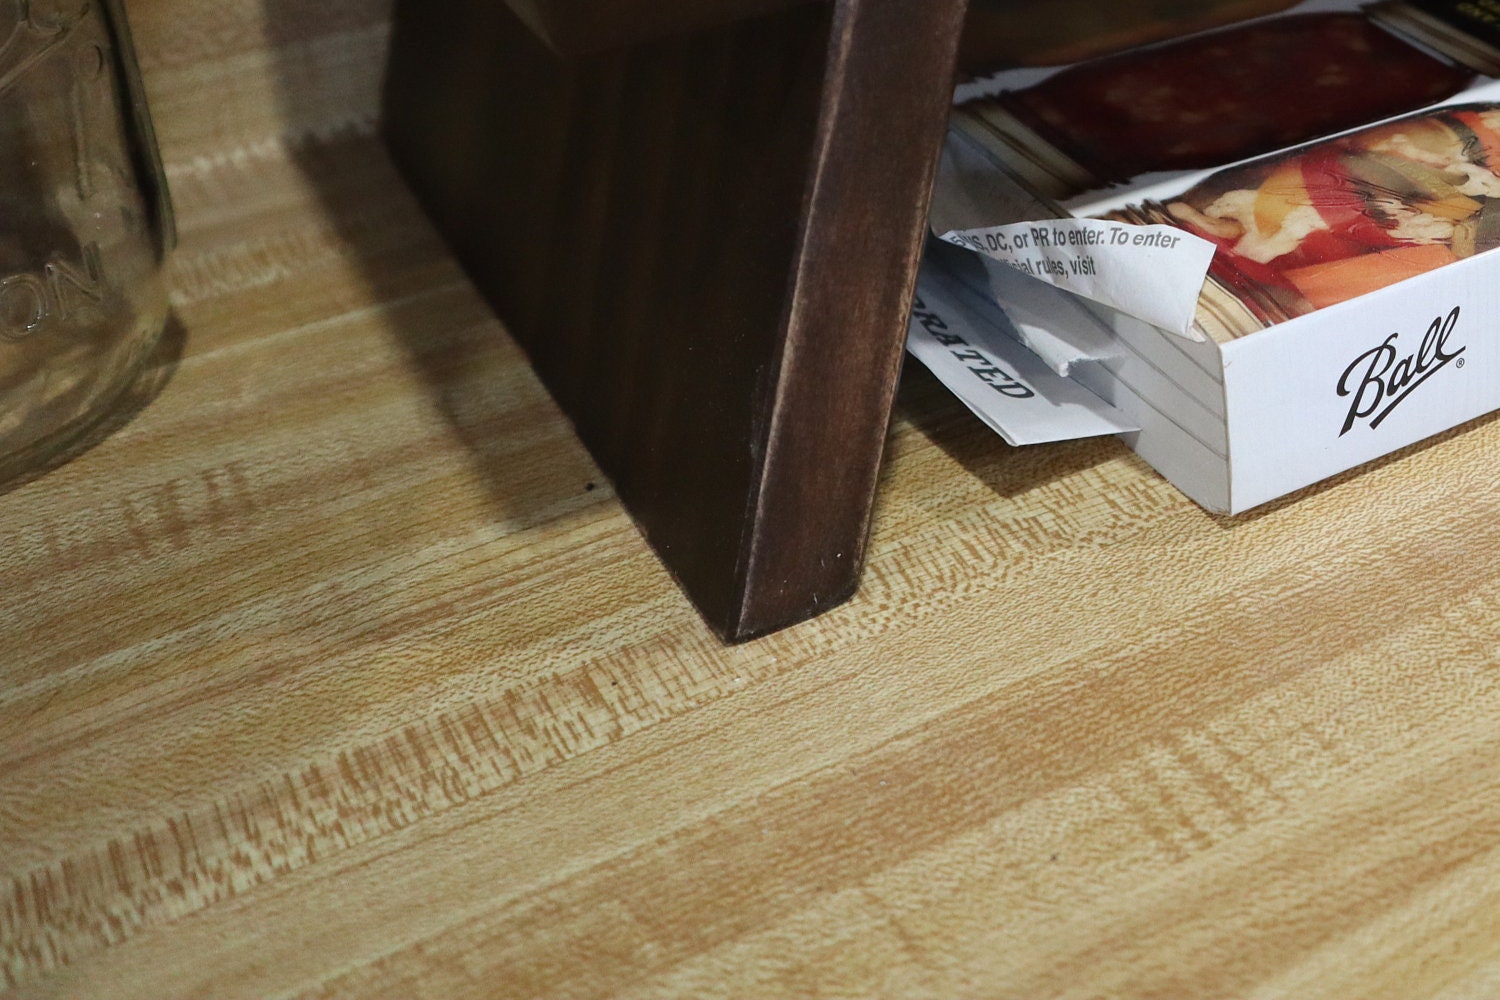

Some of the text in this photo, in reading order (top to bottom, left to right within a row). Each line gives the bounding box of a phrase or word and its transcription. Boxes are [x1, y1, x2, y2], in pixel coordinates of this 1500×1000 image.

[1013, 233, 1028, 250] or
[1030, 227, 1050, 247] PR
[1052, 228, 1067, 247] to
[1068, 227, 1105, 247] enter.
[1109, 227, 1130, 246] To
[1133, 230, 1181, 251] enter
[1036, 256, 1069, 279] rules,
[1071, 256, 1096, 277] visit
[1336, 306, 1467, 438] Ball
